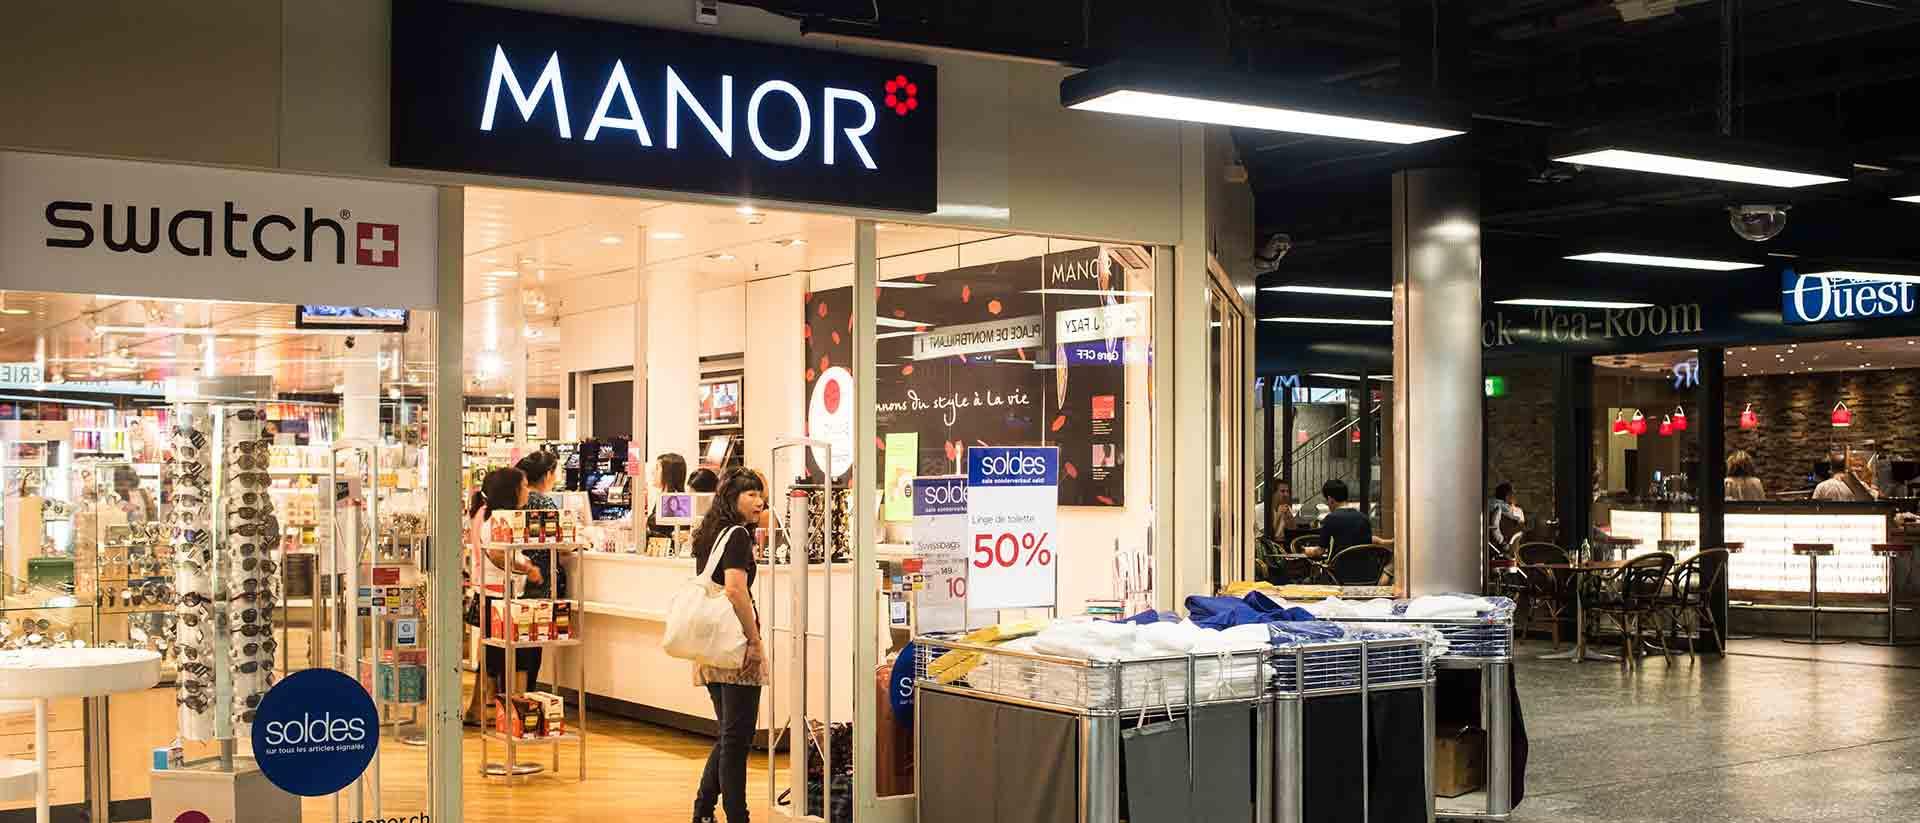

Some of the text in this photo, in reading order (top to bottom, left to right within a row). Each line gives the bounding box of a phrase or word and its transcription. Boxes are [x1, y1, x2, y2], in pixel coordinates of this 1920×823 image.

[480, 44, 880, 170] MANOR
[45, 201, 346, 265] swatch
[1794, 274, 1914, 321] Ouest
[1534, 303, 1704, 343] Tea-Room
[907, 389, 929, 410] du
[933, 393, 969, 426] style
[987, 390, 1003, 406] la
[1007, 388, 1030, 405] vie
[981, 451, 1046, 475] soldes
[973, 532, 1051, 568] 50%
[265, 712, 366, 745] soldes
[278, 746, 295, 754] tous
[296, 745, 307, 753] les
[308, 744, 334, 752] articles
